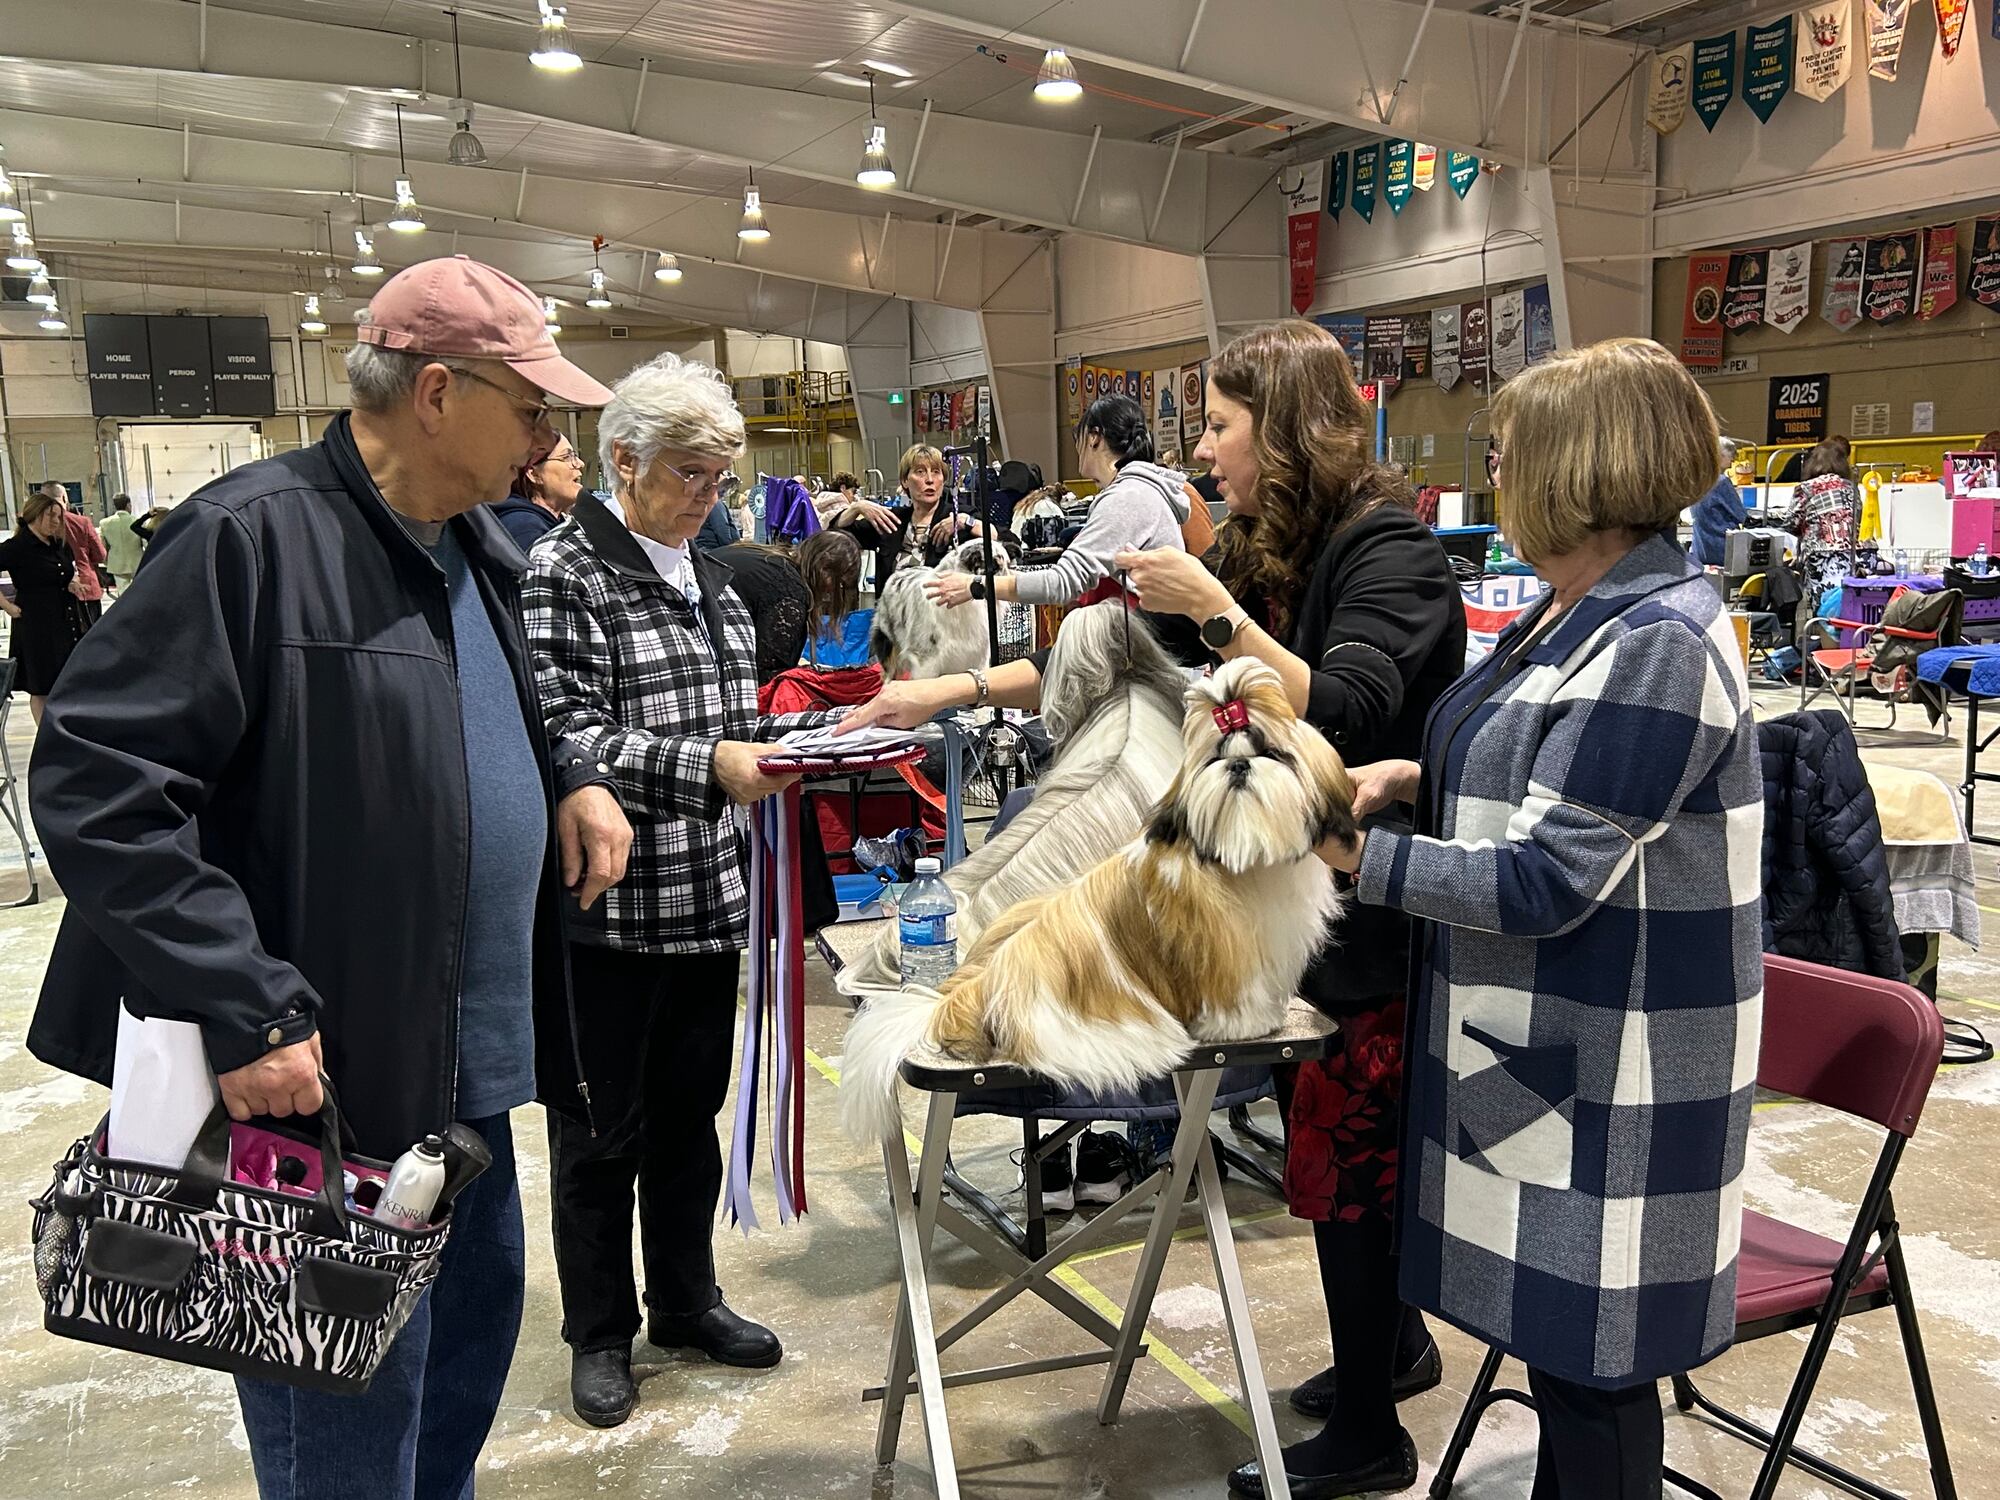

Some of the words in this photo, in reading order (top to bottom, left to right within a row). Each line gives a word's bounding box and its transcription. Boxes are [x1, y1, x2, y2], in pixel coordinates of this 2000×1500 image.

[1760, 55, 1778, 68] TYKE
[1702, 68, 1720, 80] ATOM
[1806, 70, 1840, 84] CHAMPIONS
[1698, 264, 1721, 272] 2015
[1872, 278, 1908, 292] Novice
[1865, 288, 1910, 306] Champions
[1880, 302, 1898, 316] 2014
[106, 354, 132, 362] HOME
[227, 356, 256, 364] VISITOR
[1730, 360, 1748, 372] PEN
[1779, 382, 1820, 406] 2025
[1775, 406, 1822, 420] ORANGEVILLE
[1784, 422, 1810, 433] TIGERS
[384, 1198, 425, 1220] KENRA
